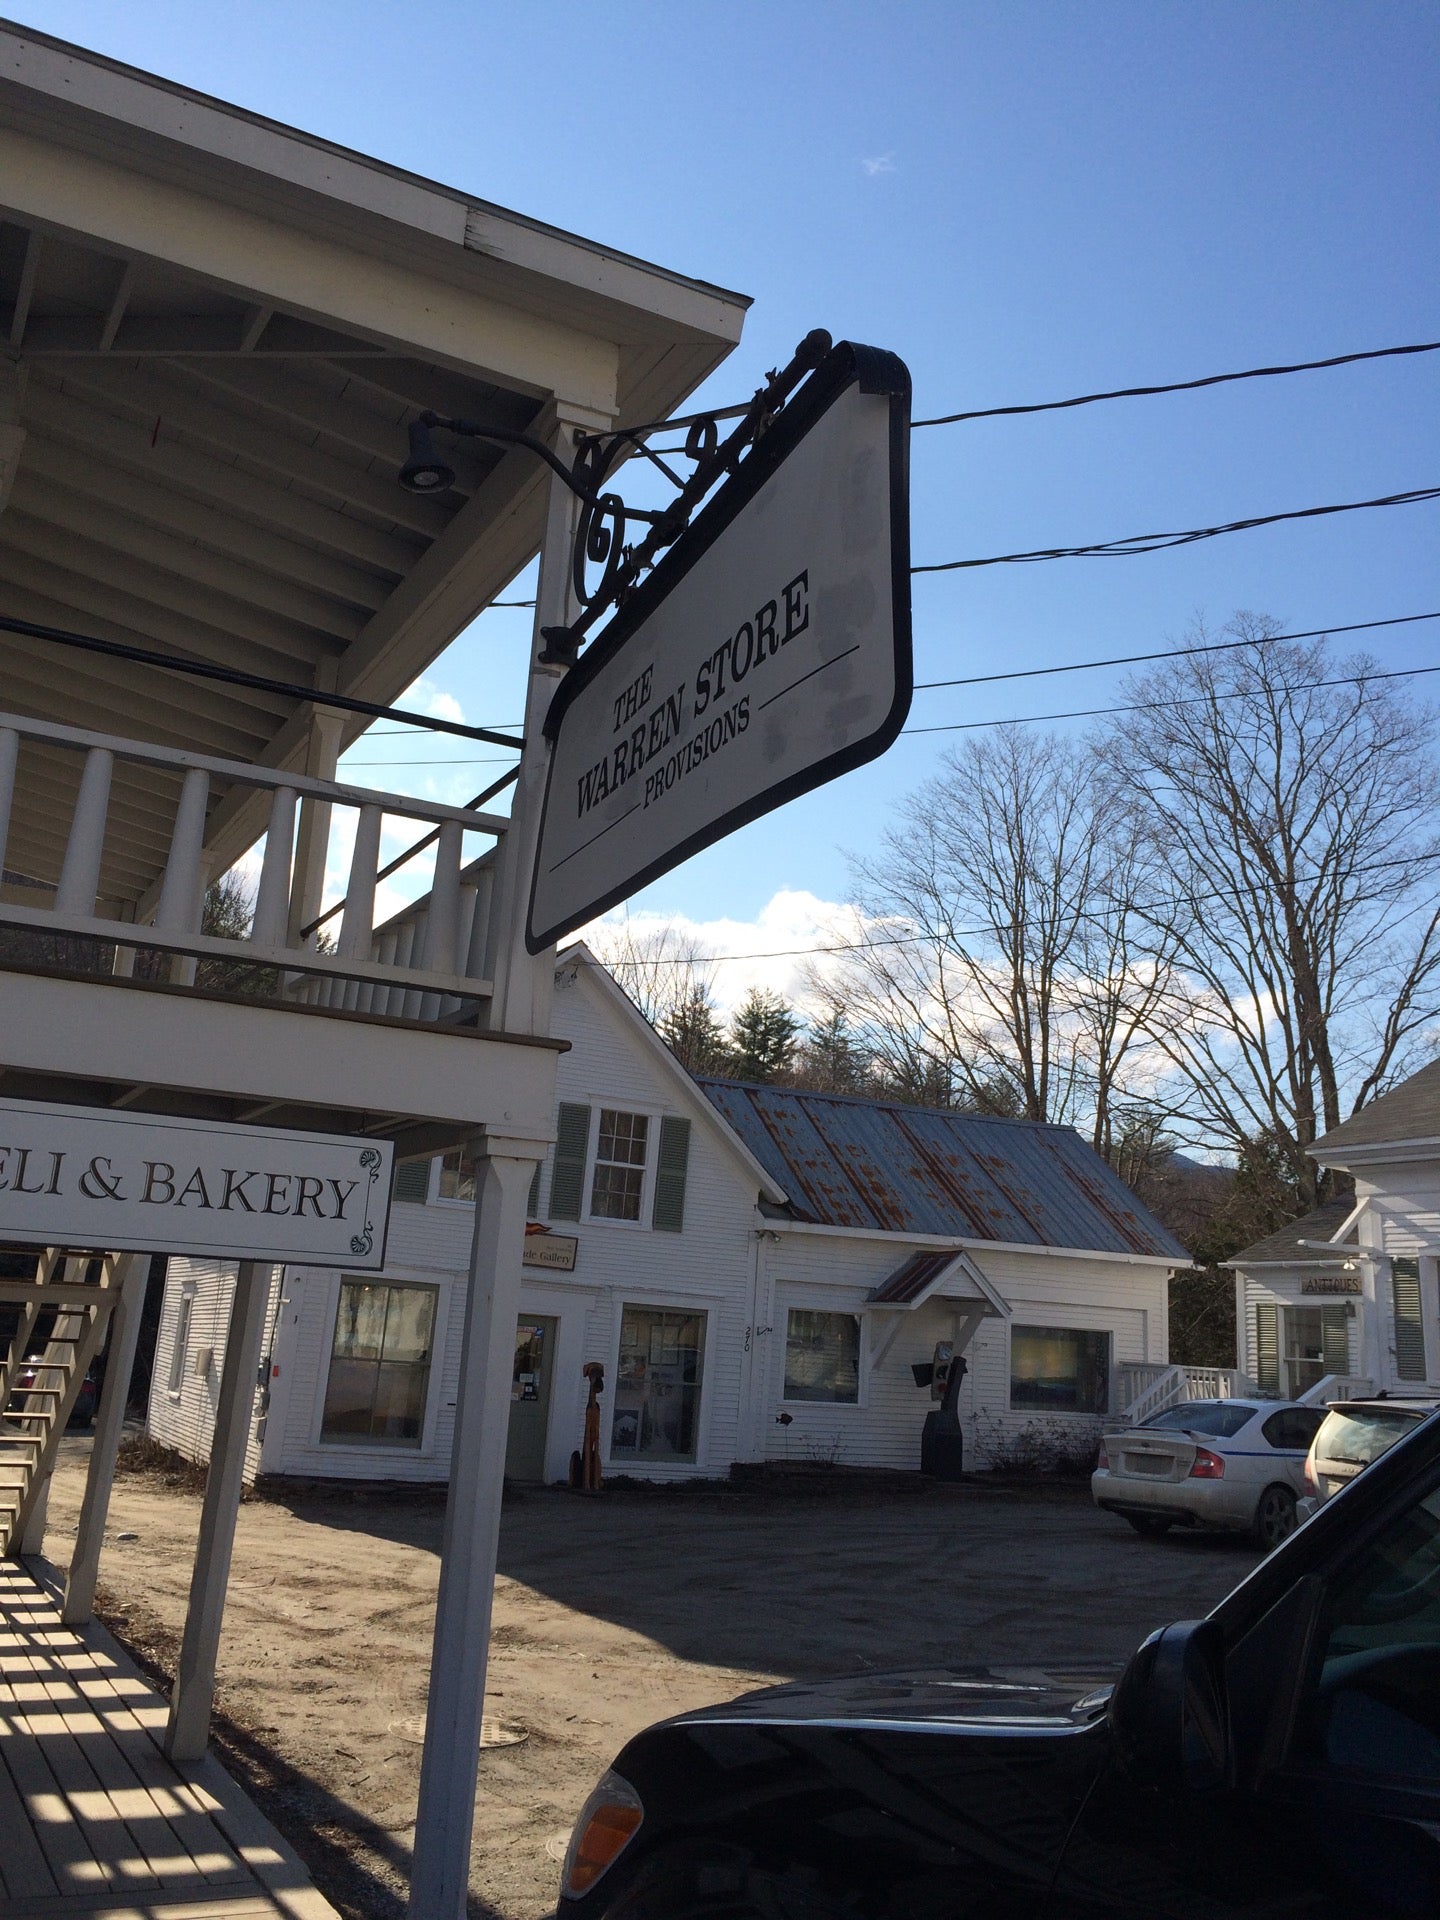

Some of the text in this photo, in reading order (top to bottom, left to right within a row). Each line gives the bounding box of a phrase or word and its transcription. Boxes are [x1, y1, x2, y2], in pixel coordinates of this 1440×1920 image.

[577, 569, 809, 818] WARREN STORE
[613, 664, 653, 733] THE
[643, 695, 750, 809] PROVISIONS
[78, 1156, 127, 1201] &
[139, 1160, 360, 1220] BAKERY
[540, 1251, 570, 1266] Gallery
[1305, 1279, 1359, 1292] ANTIQUES
